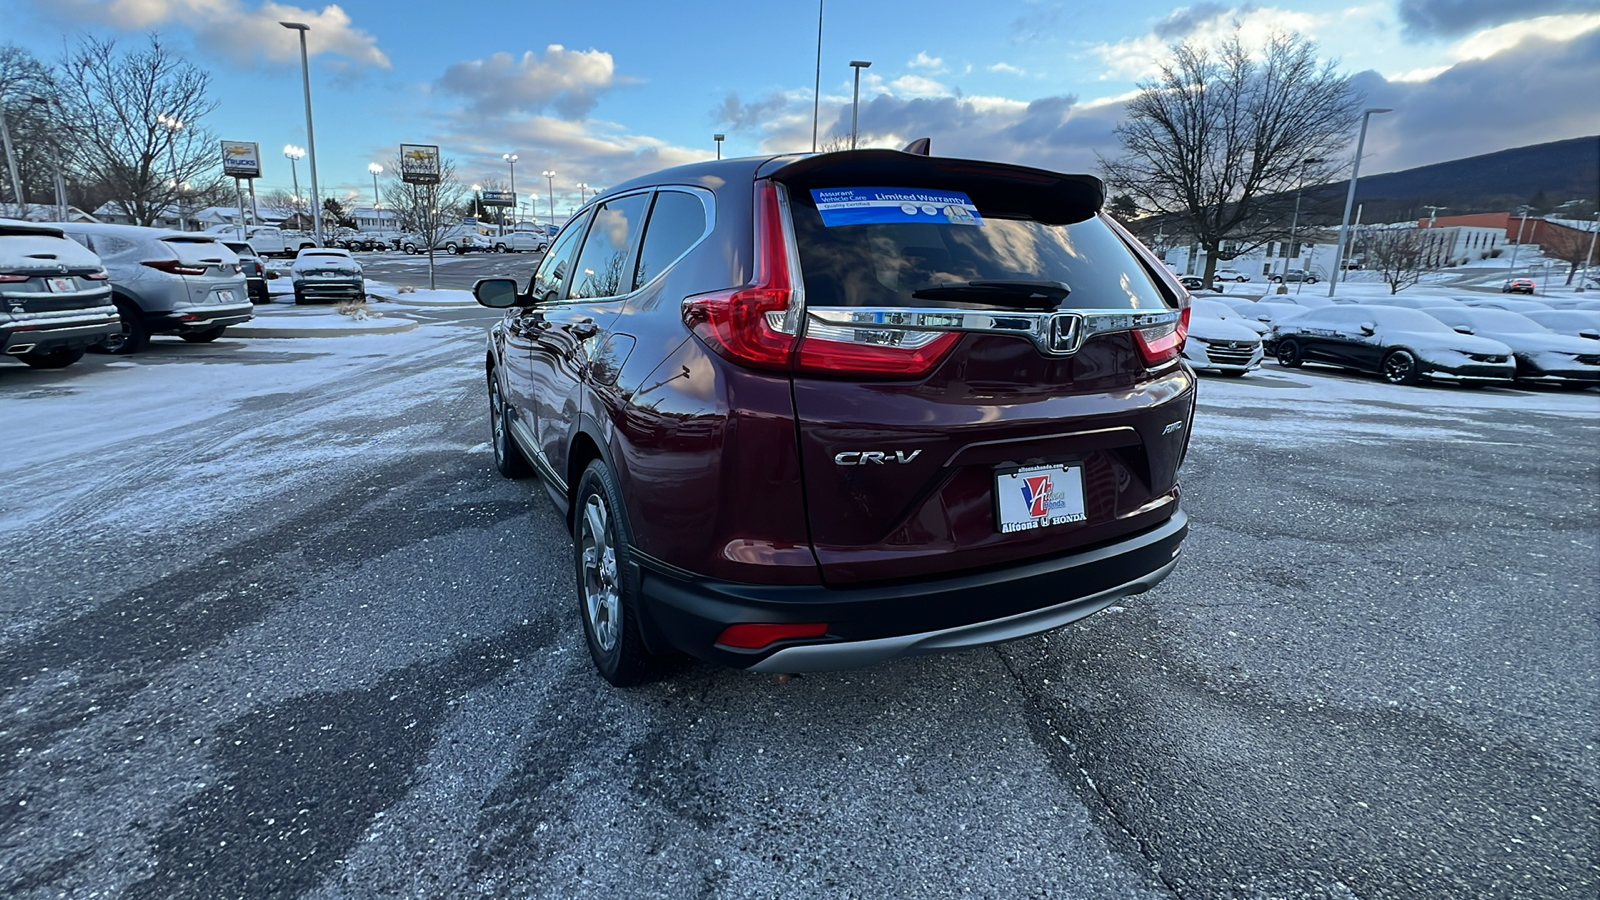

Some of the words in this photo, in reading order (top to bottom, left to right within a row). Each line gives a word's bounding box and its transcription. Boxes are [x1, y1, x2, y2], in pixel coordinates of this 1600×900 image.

[819, 190, 853, 198] Assurant
[875, 193, 916, 201] Limited
[917, 194, 965, 204] Warranty
[834, 449, 922, 466] CR-V
[1018, 463, 1064, 473] altoonahonda.com
[1002, 520, 1039, 534] Altoona
[1052, 513, 1087, 525] HONDA
